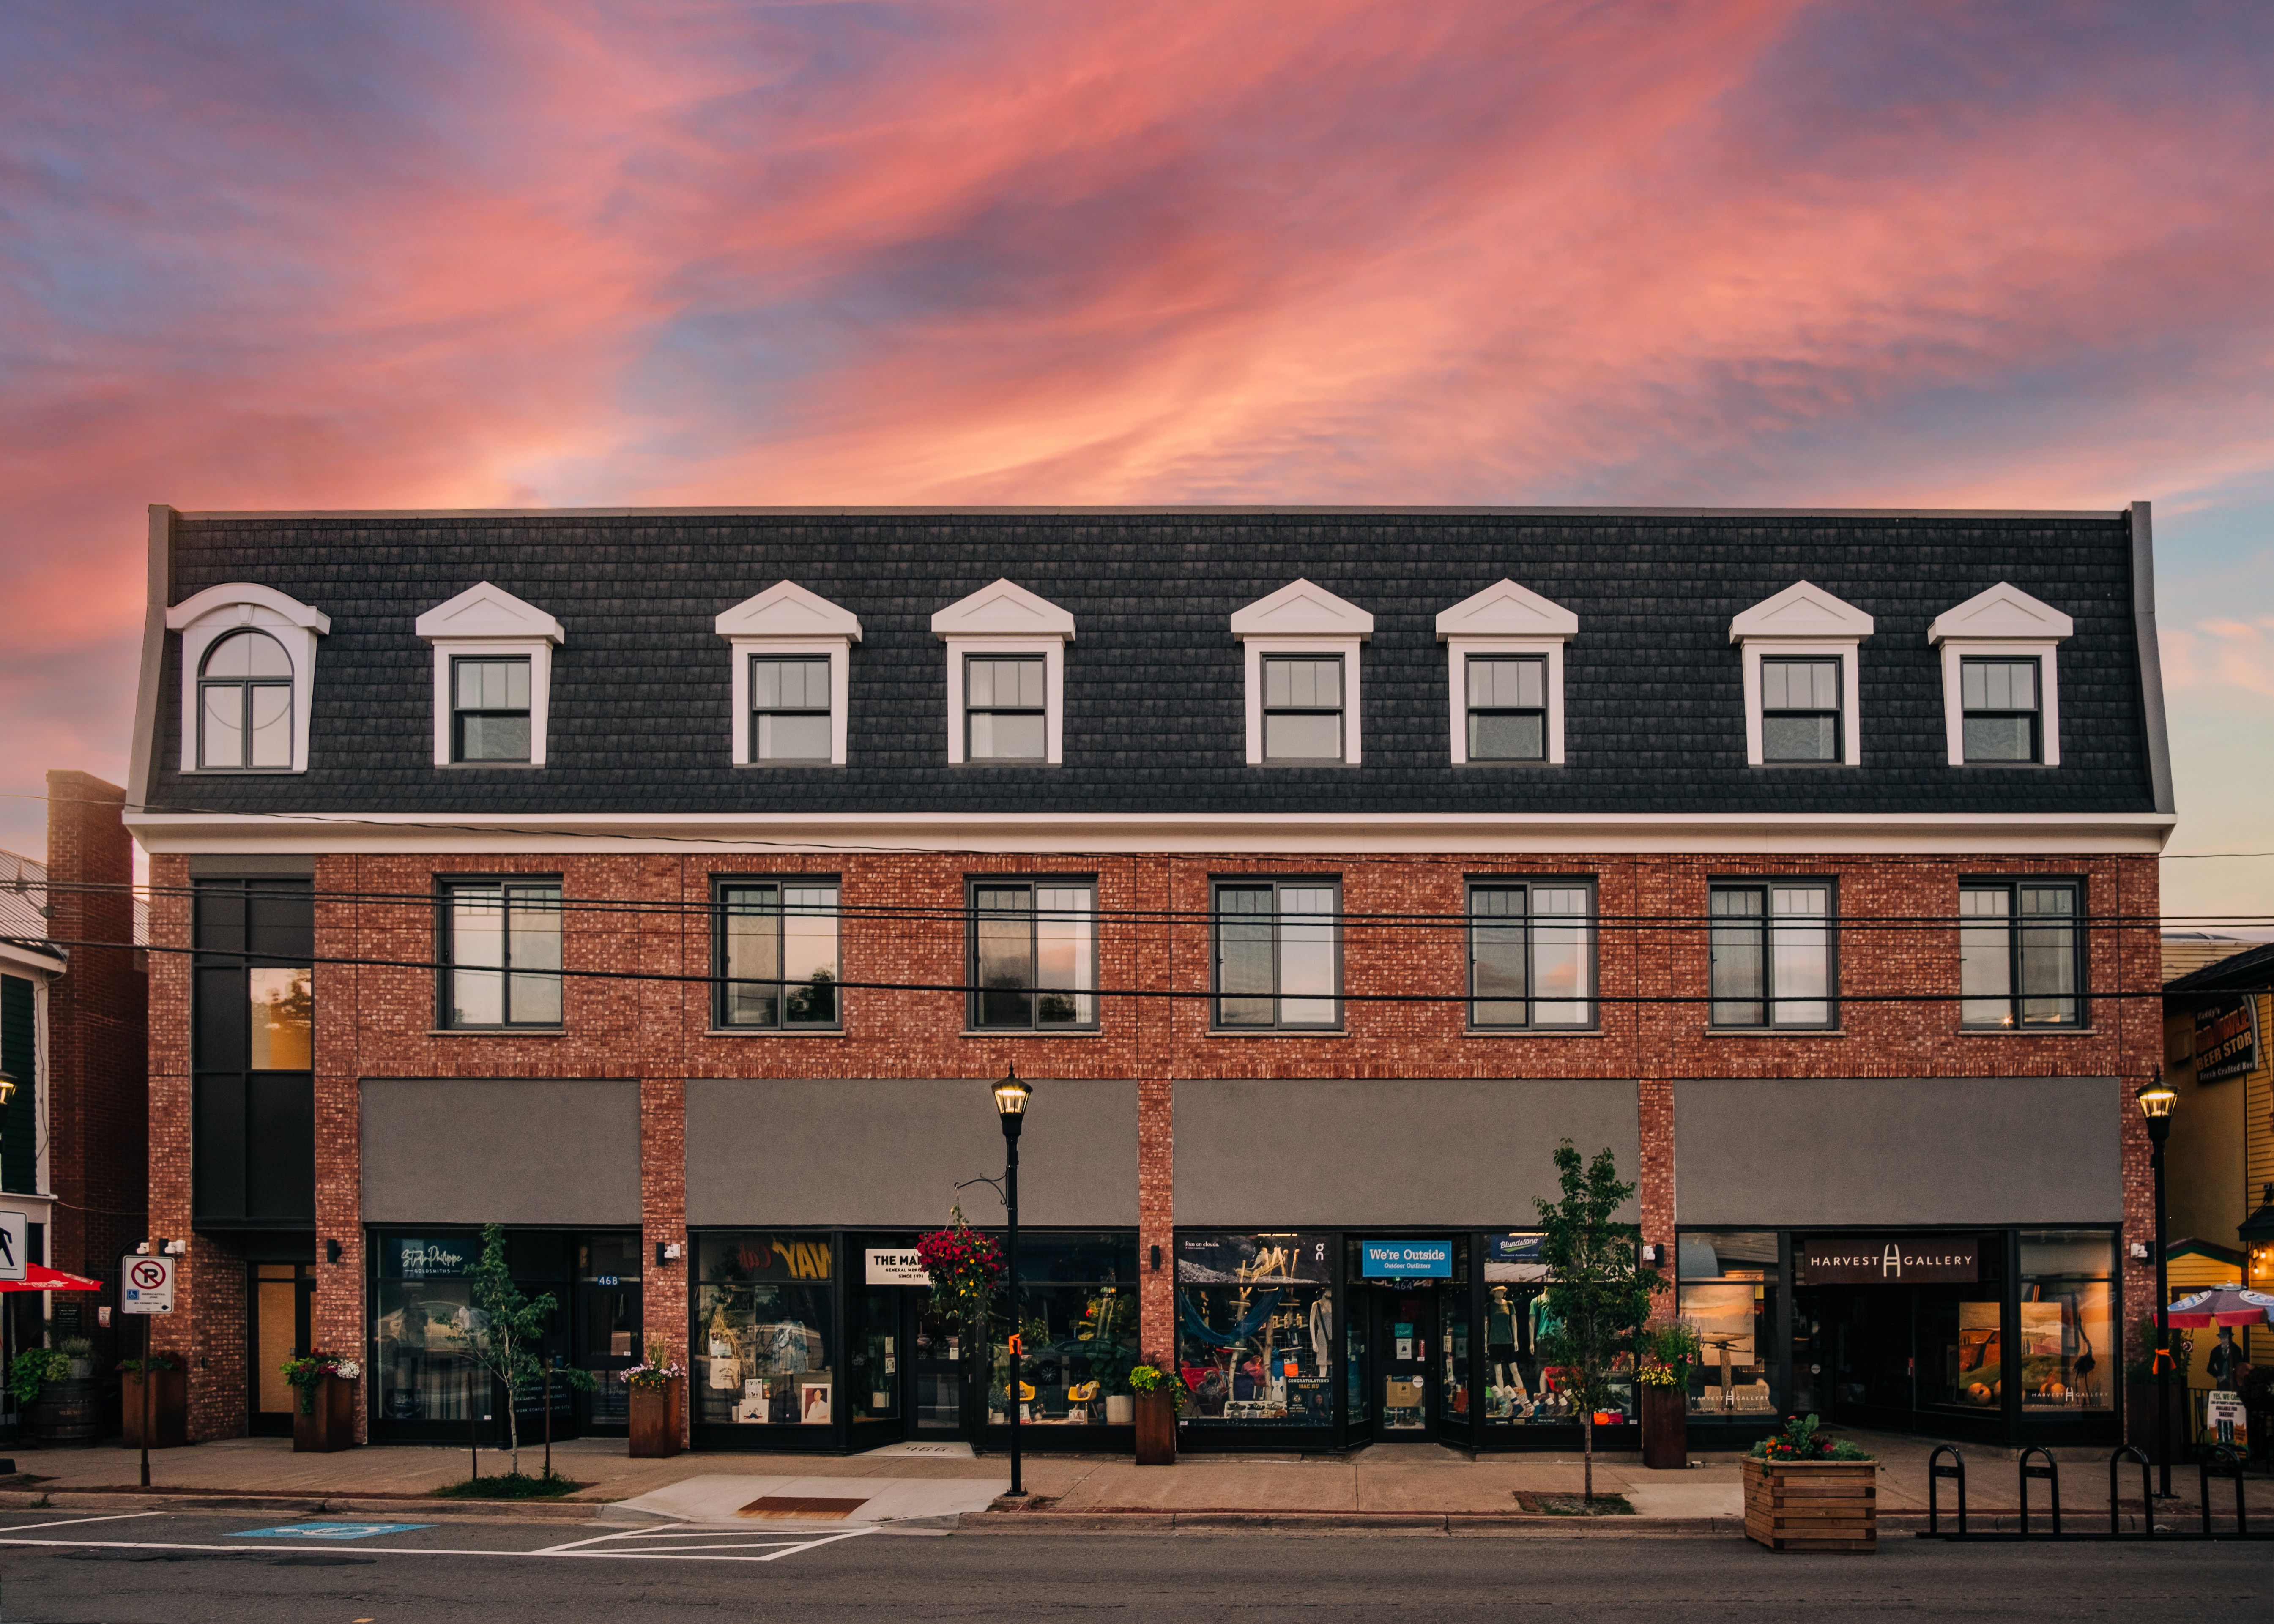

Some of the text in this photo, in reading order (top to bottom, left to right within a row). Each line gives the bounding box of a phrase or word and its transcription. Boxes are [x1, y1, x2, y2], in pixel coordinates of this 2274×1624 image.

[2196, 1047, 2222, 1071] BEER
[2200, 1070, 2216, 1080] Fresh
[2217, 1063, 2241, 1075] Crafted
[1500, 1238, 1539, 1249] Blundstone
[1369, 1249, 1445, 1260] We're Outside
[873, 1255, 896, 1265] THE
[1811, 1257, 1880, 1266] HARVEST
[1904, 1256, 1972, 1266] GALLERY
[599, 1276, 618, 1285] 468
[1394, 1281, 1413, 1290] 464
